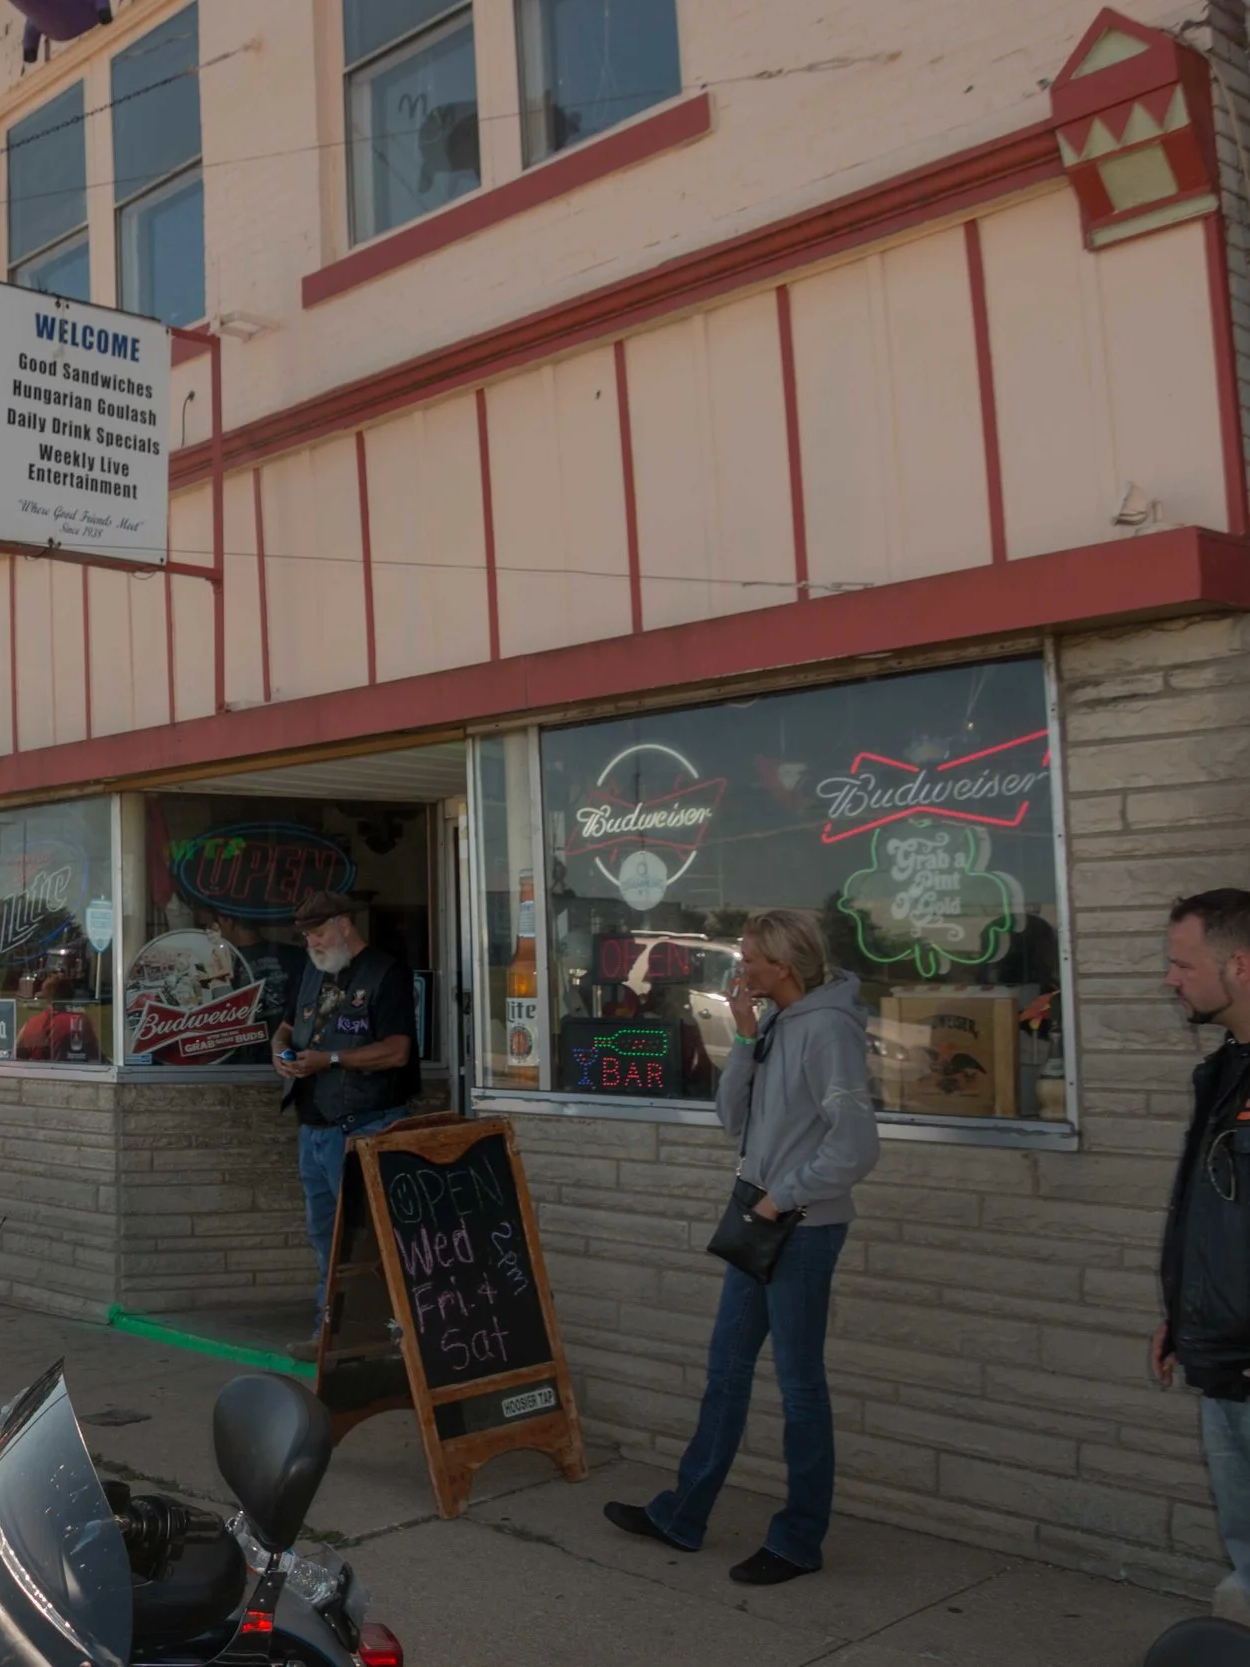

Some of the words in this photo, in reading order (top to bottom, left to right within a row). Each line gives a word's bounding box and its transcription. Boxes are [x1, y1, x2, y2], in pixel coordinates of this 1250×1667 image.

[35, 312, 140, 362] WELCOME
[19, 353, 56, 376] Good
[63, 363, 153, 399] Sandwiches
[13, 379, 91, 412] Hungarian
[98, 398, 156, 426] Goulash
[7, 408, 46, 433] Daily
[52, 417, 91, 441] Drink
[96, 427, 160, 455] Specials
[28, 463, 137, 500] Entertainment
[39, 443, 95, 471] Weekly
[100, 456, 129, 477] Live
[53, 505, 77, 521] Good
[816, 768, 1049, 818] Budweiser
[576, 802, 712, 837] Budweiser
[196, 842, 338, 905] OPEN
[887, 836, 949, 881] Grab
[908, 870, 961, 898] Pint
[138, 1002, 263, 1040] Budweiser
[184, 1040, 215, 1053] GRAB
[235, 1030, 265, 1043] BUDS
[602, 1057, 664, 1088] BAR
[390, 1155, 505, 1227] OPEN
[393, 1217, 474, 1277] Wed
[441, 1316, 509, 1370] Sat
[504, 1394, 536, 1415] HOOSIER
[538, 1391, 552, 1406] TAP
